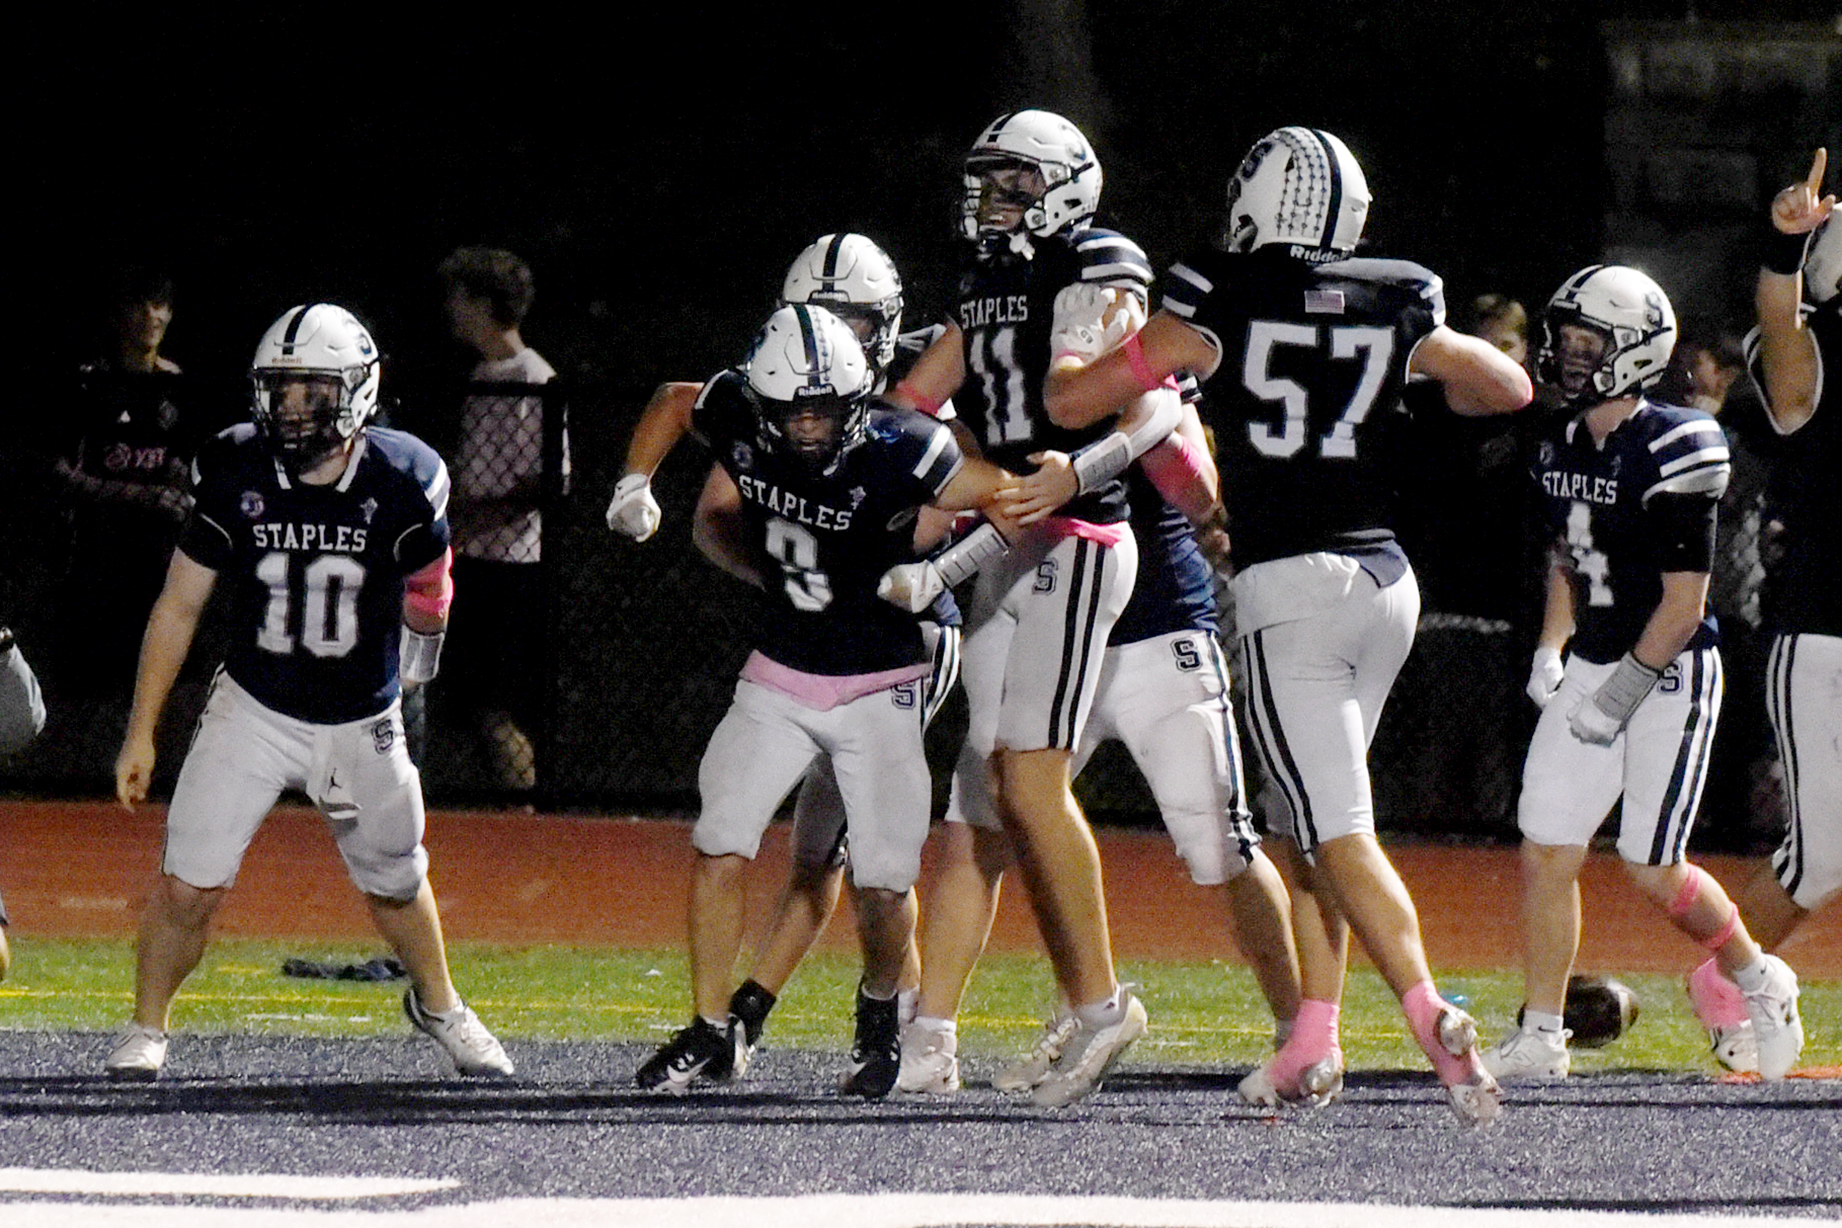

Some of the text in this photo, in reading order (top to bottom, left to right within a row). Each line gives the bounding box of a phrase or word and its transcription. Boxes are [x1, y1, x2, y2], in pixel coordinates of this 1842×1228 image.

[960, 295, 1029, 330] STAPLES
[969, 328, 1033, 446] 11
[1243, 319, 1396, 459] 57
[739, 474, 853, 531] STAPLES
[1542, 471, 1619, 505] STAPLES
[252, 522, 368, 553] STAPLES
[1566, 500, 1615, 608] 4
[1031, 557, 1059, 596] S
[256, 551, 367, 659] 10
[1169, 637, 1204, 673] S
[1657, 660, 1684, 696] S
[370, 718, 394, 756] S
